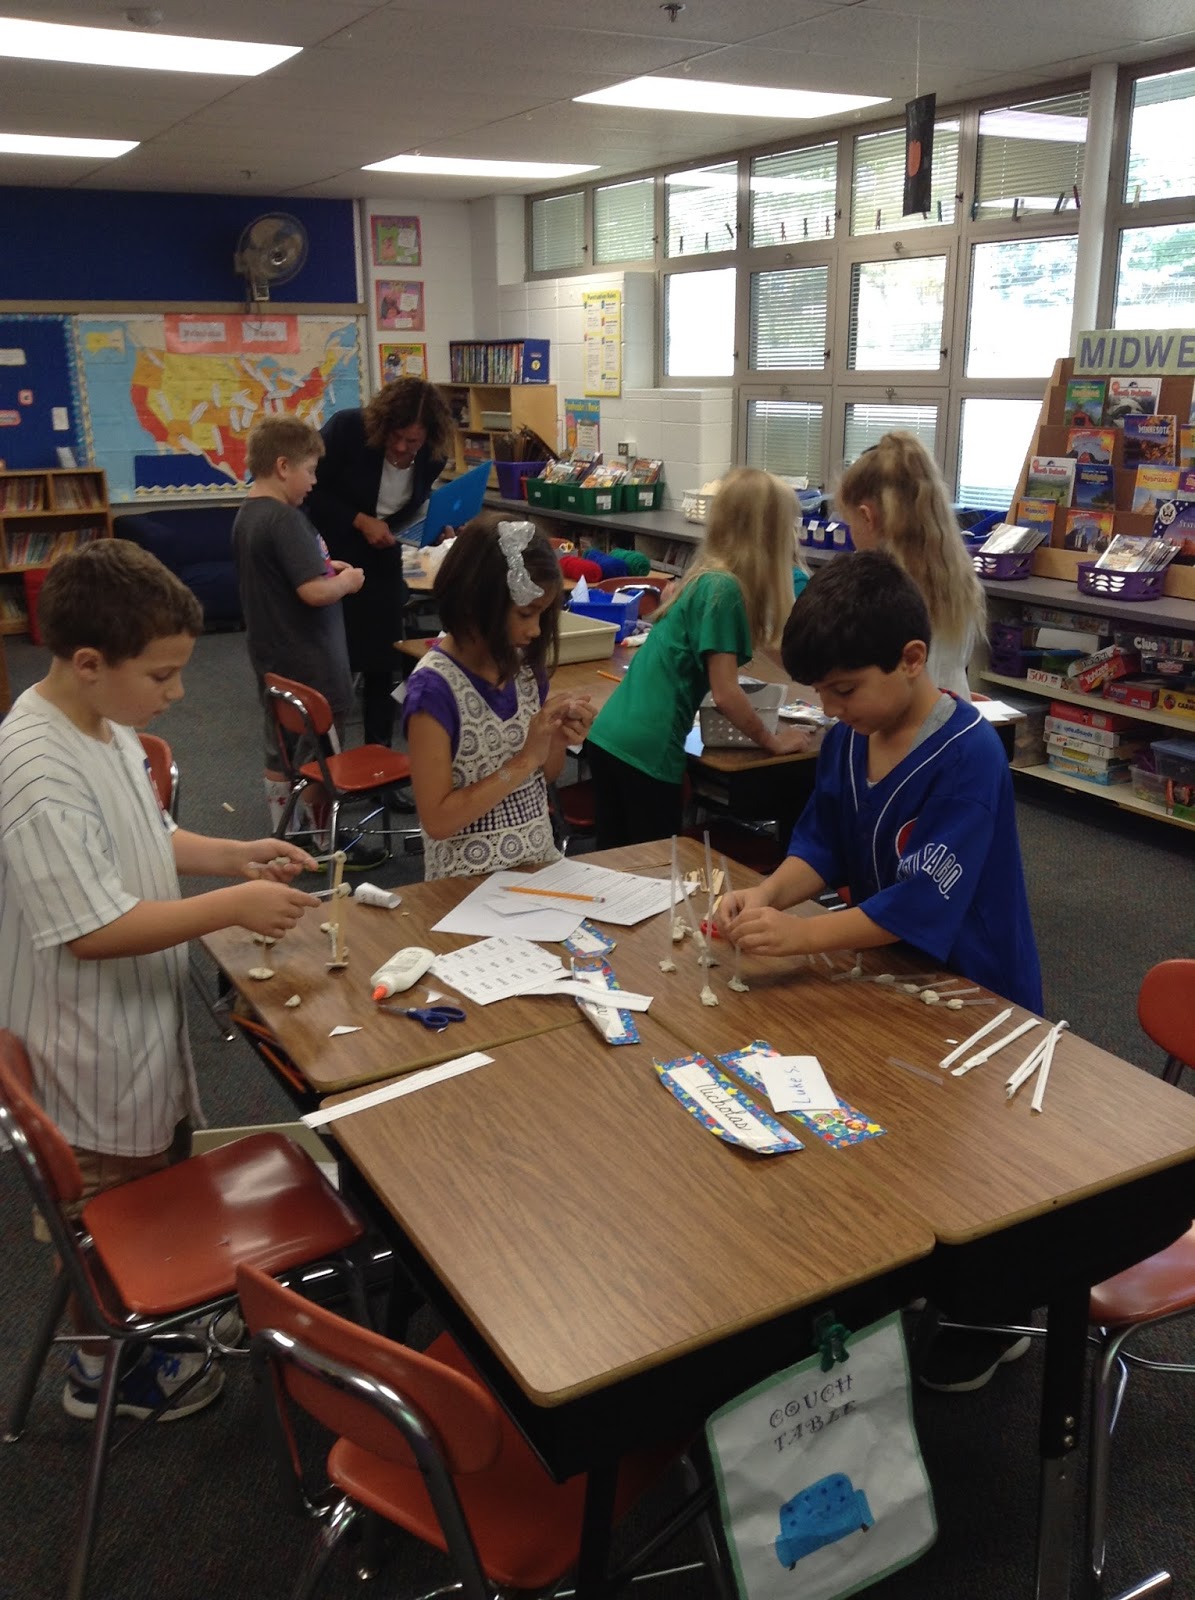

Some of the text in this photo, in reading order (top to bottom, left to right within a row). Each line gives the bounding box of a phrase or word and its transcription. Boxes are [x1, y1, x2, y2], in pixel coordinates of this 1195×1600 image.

[1079, 335, 1195, 369] MIDWE
[1138, 425, 1170, 434] MINNESOTA
[1133, 636, 1158, 651] Clue
[1029, 670, 1049, 683] 500
[897, 843, 963, 895] ICAGO
[696, 1082, 752, 1133] Nicholas
[768, 1374, 854, 1429] COUCH
[773, 1399, 857, 1453] TABLE
